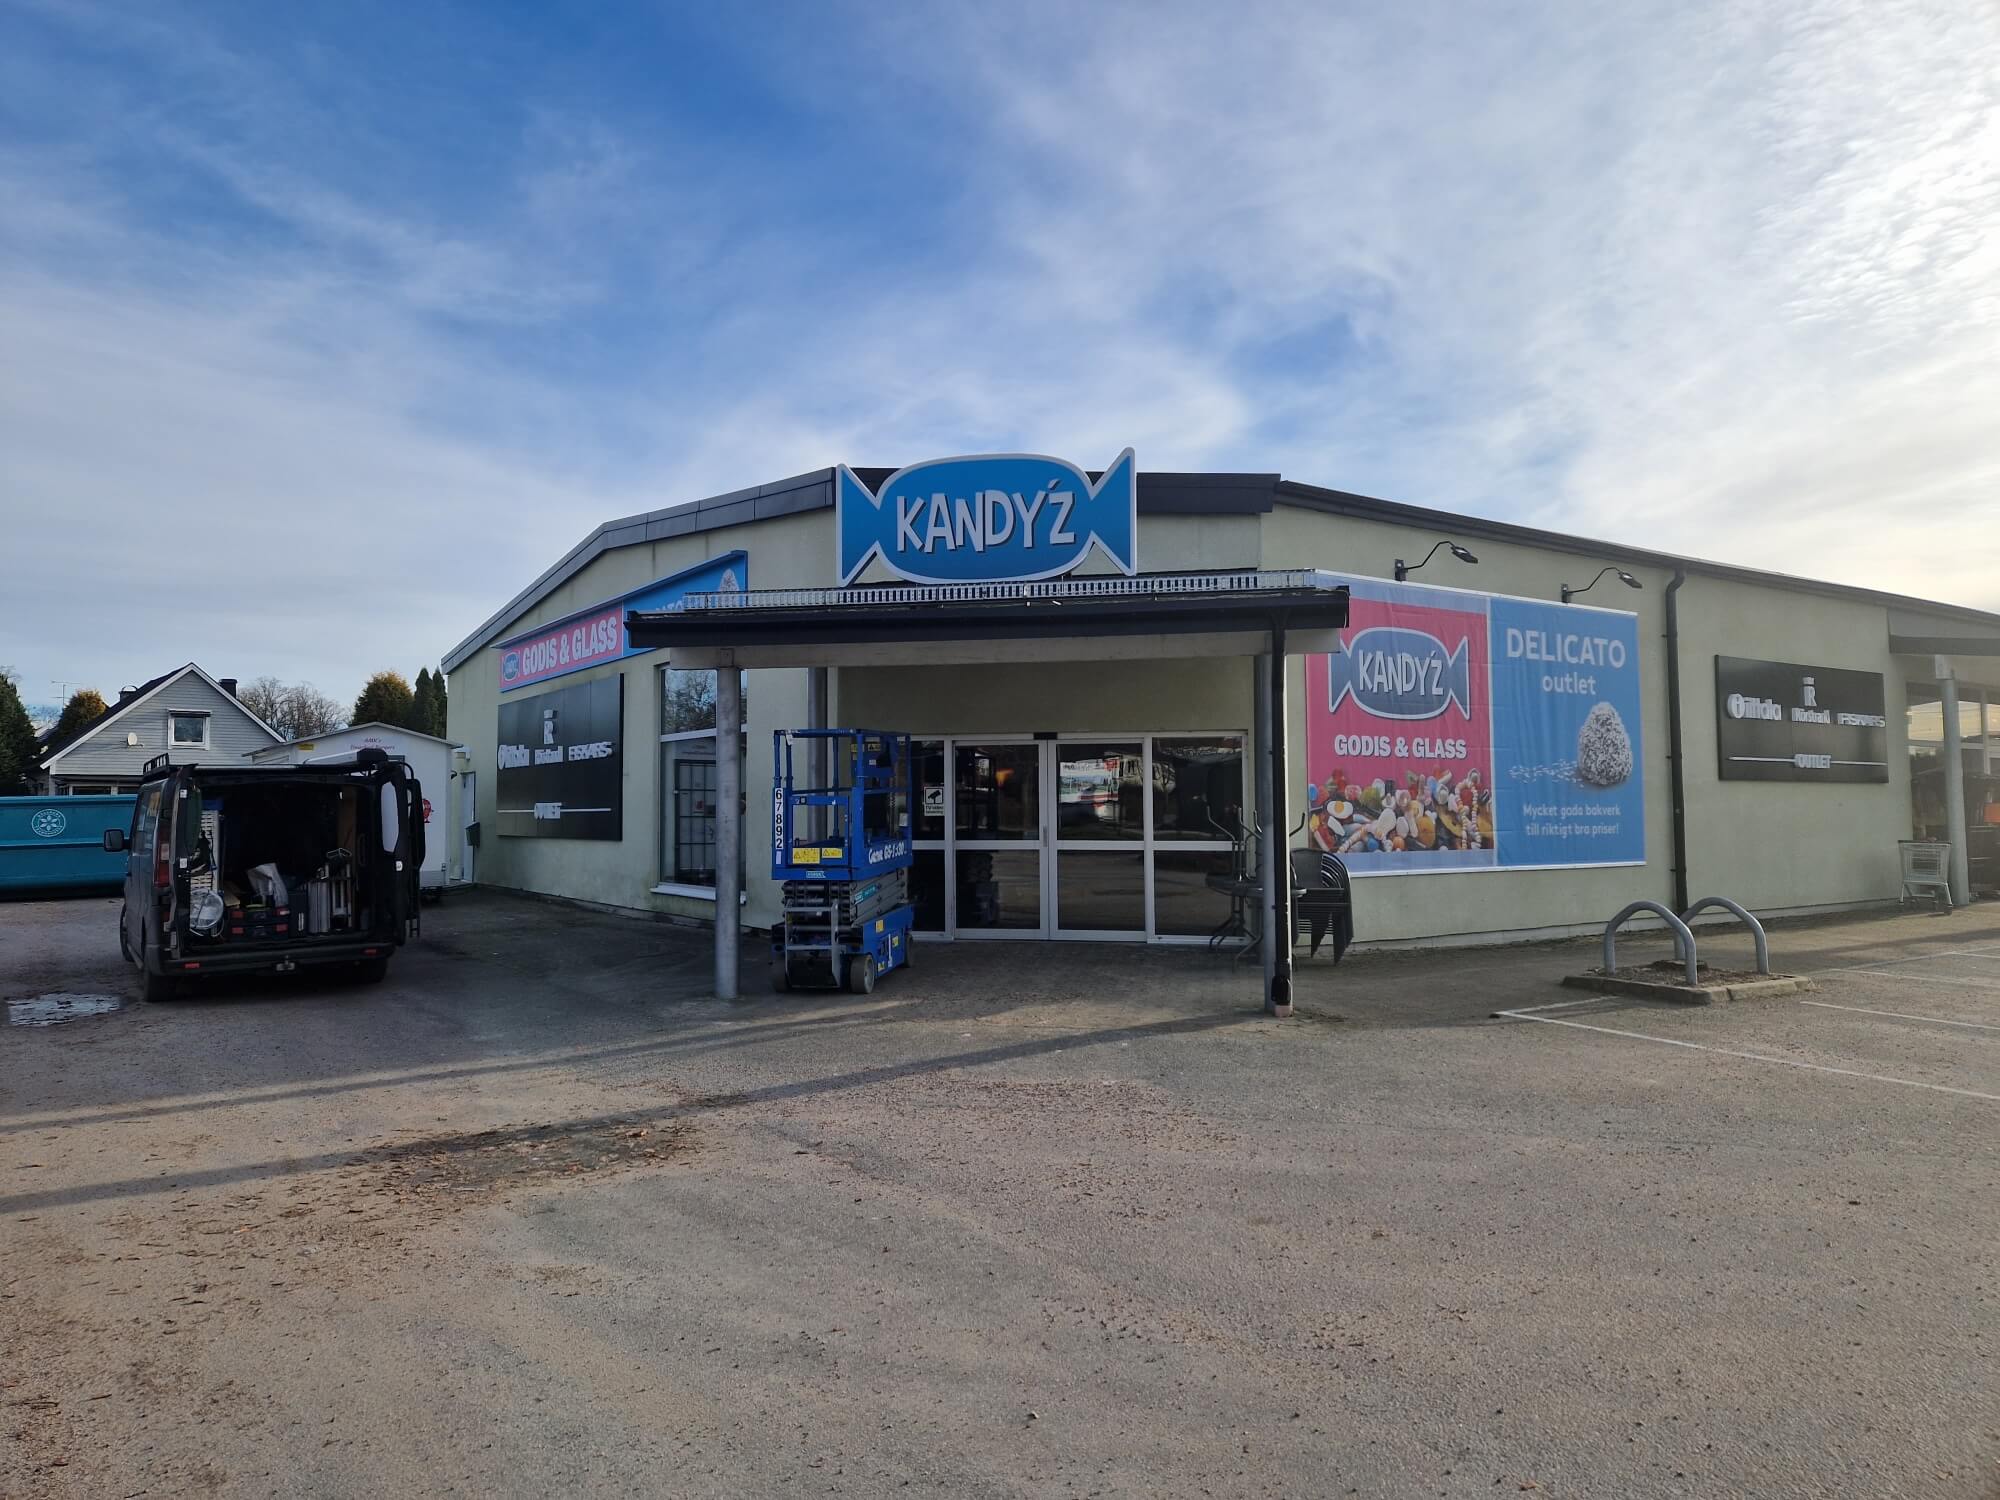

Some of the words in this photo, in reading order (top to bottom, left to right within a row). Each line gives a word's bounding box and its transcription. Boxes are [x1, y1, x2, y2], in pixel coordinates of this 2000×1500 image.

[523, 638, 557, 675] GODIS
[559, 633, 569, 665] &
[572, 616, 617, 661] GLASS
[1506, 628, 1626, 669] DELICATO
[1542, 672, 1597, 695] outlet
[1334, 734, 1391, 757] GODIS
[1394, 736, 1409, 758] &
[1412, 737, 1467, 759] GLASS
[775, 789, 783, 849] 67892
[1523, 803, 1558, 820] Mycket
[1561, 804, 1583, 819] goda
[1585, 803, 1620, 816] bakverk
[1526, 823, 1539, 836] till
[1541, 822, 1572, 839] riktigt
[1574, 822, 1590, 835] bra
[1592, 822, 1619, 838] priser!
